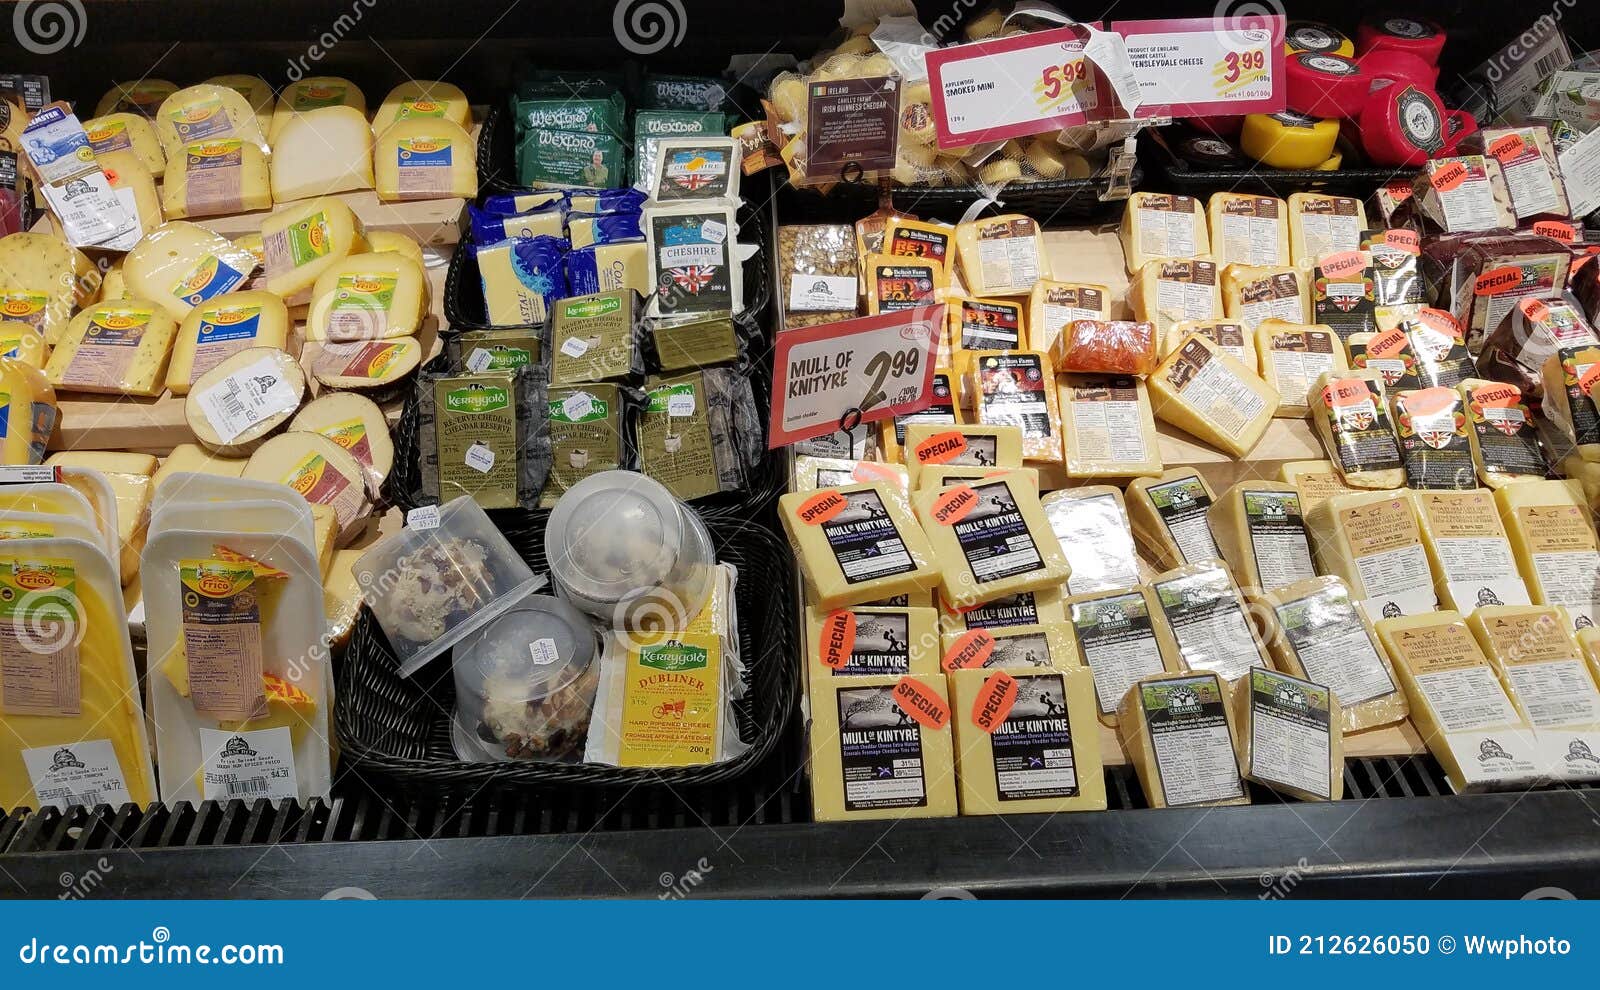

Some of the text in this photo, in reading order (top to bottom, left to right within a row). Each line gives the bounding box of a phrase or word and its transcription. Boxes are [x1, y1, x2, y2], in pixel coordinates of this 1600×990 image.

[1178, 58, 1204, 66] CHEESE
[828, 86, 849, 95] IRELAND
[945, 82, 995, 97] SMOKED MINI
[1490, 137, 1523, 159] SPECIAL
[1433, 167, 1465, 190] SPECIAL
[1388, 186, 1411, 195] SPEC
[1535, 226, 1572, 241] SPECIAL
[668, 246, 718, 258] CHESHIRE
[1323, 257, 1363, 274] SPECIAL
[1476, 271, 1519, 291] SPECIAL
[1371, 332, 1404, 356] SPECIAL
[790, 350, 854, 380] MULL OF
[788, 370, 849, 399] KNITYRE
[448, 393, 506, 406] Kerrygold
[1475, 388, 1516, 404] SPECIAL
[919, 437, 963, 462] SPECIAL
[801, 495, 842, 522] SPECIAL
[935, 490, 973, 522] SPECIAL
[826, 518, 893, 538] MULL KINTYRE
[955, 512, 1022, 535] MULL KINTYRE
[202, 579, 229, 590] Frico
[997, 605, 1036, 619] KINTYRE
[826, 613, 849, 666] SPECIAL
[642, 650, 706, 665] Kerrygold
[844, 655, 859, 667] ULL
[867, 654, 907, 667] KINTYRE
[948, 635, 990, 672] SPECIAL
[638, 672, 705, 691] DUBLINER
[897, 683, 945, 725] SPECIAL
[978, 678, 1011, 729] SPECIAL
[1026, 719, 1068, 733] KINTYRE
[842, 731, 870, 745] MULL
[876, 728, 919, 743] KINTYRE
[689, 745, 710, 755] 200 g
